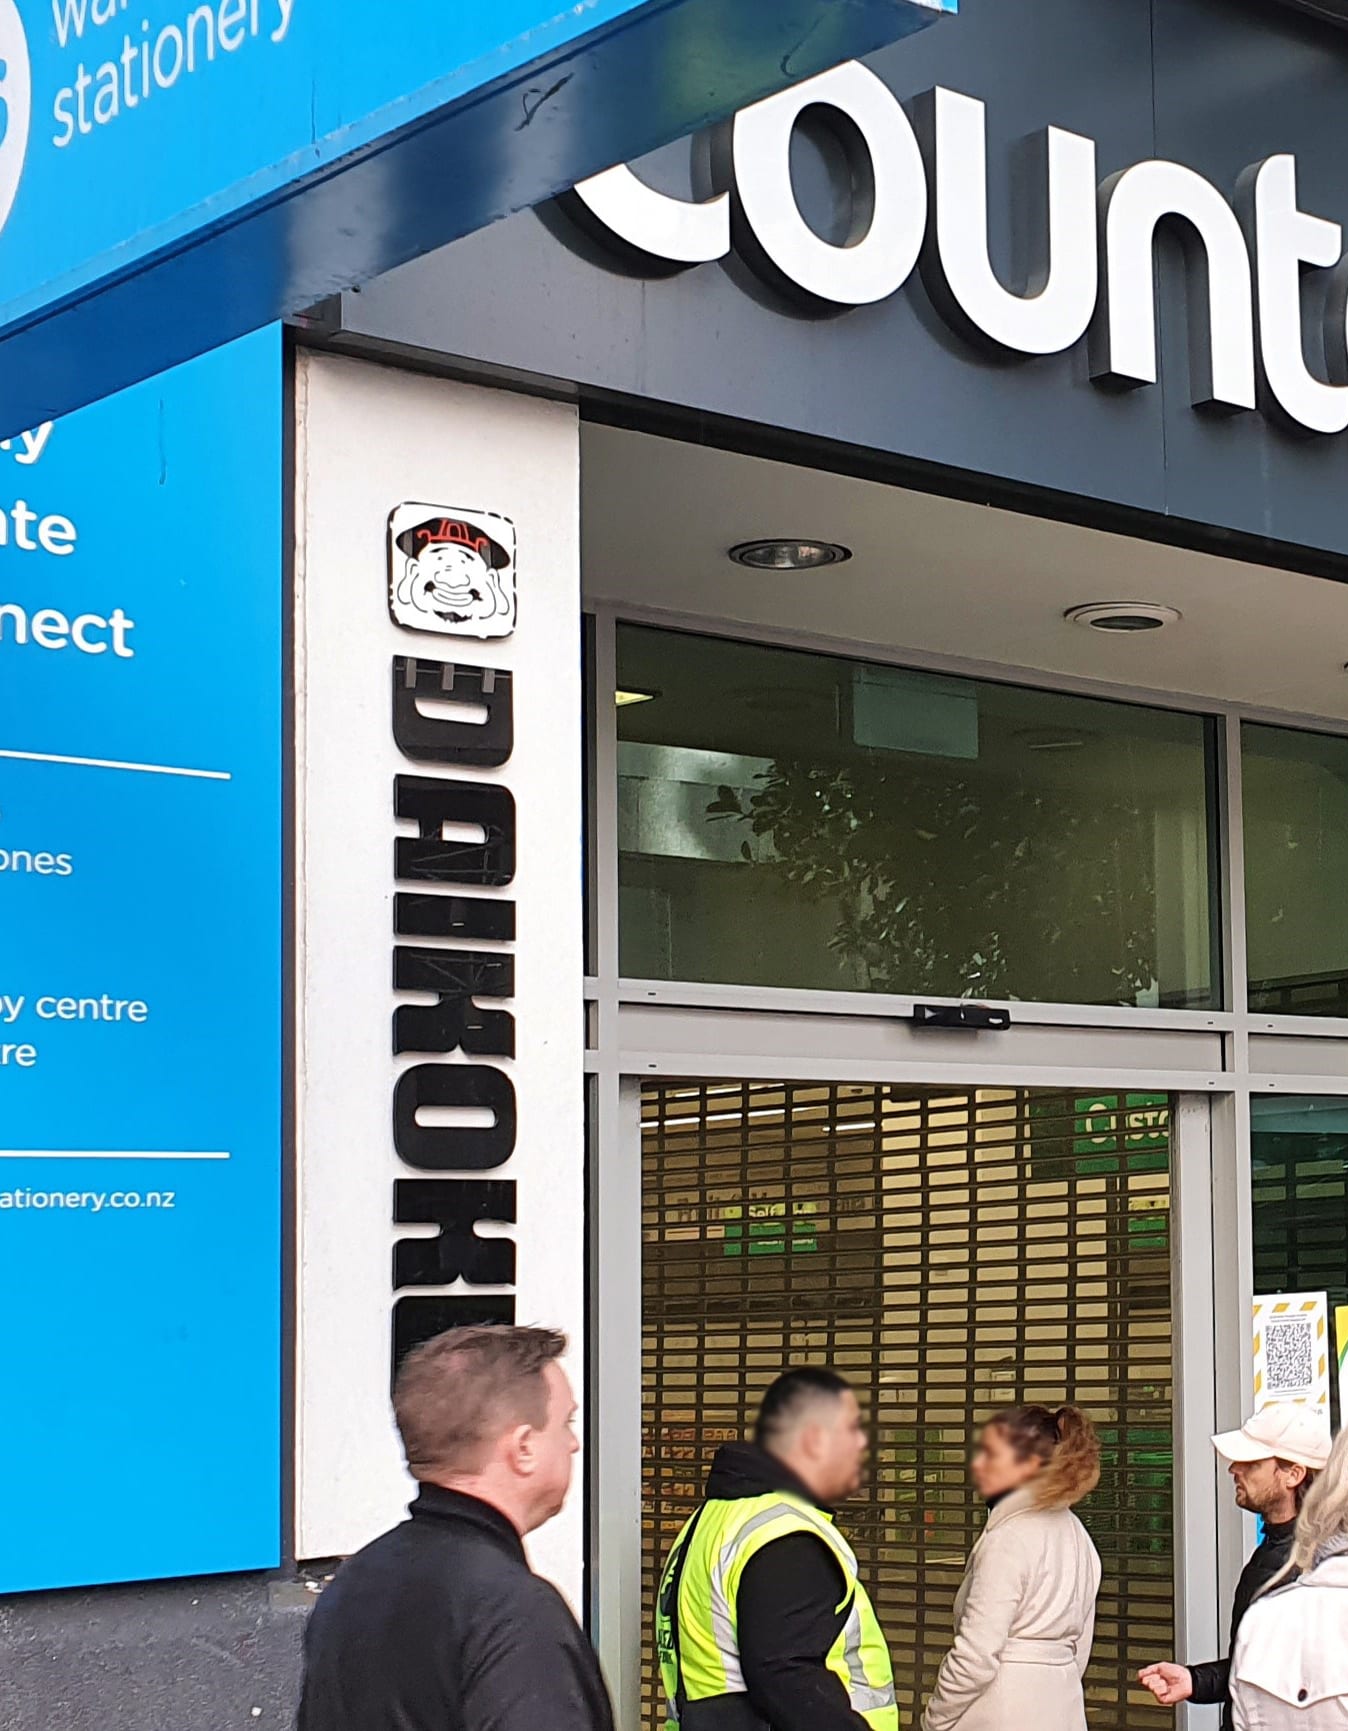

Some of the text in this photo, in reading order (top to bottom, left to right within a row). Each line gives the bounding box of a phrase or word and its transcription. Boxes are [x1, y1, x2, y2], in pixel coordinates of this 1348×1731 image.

[53, 0, 294, 147] stationery
[0, 500, 77, 555] te
[36, 993, 148, 1022] centre
[0, 1042, 37, 1067] re
